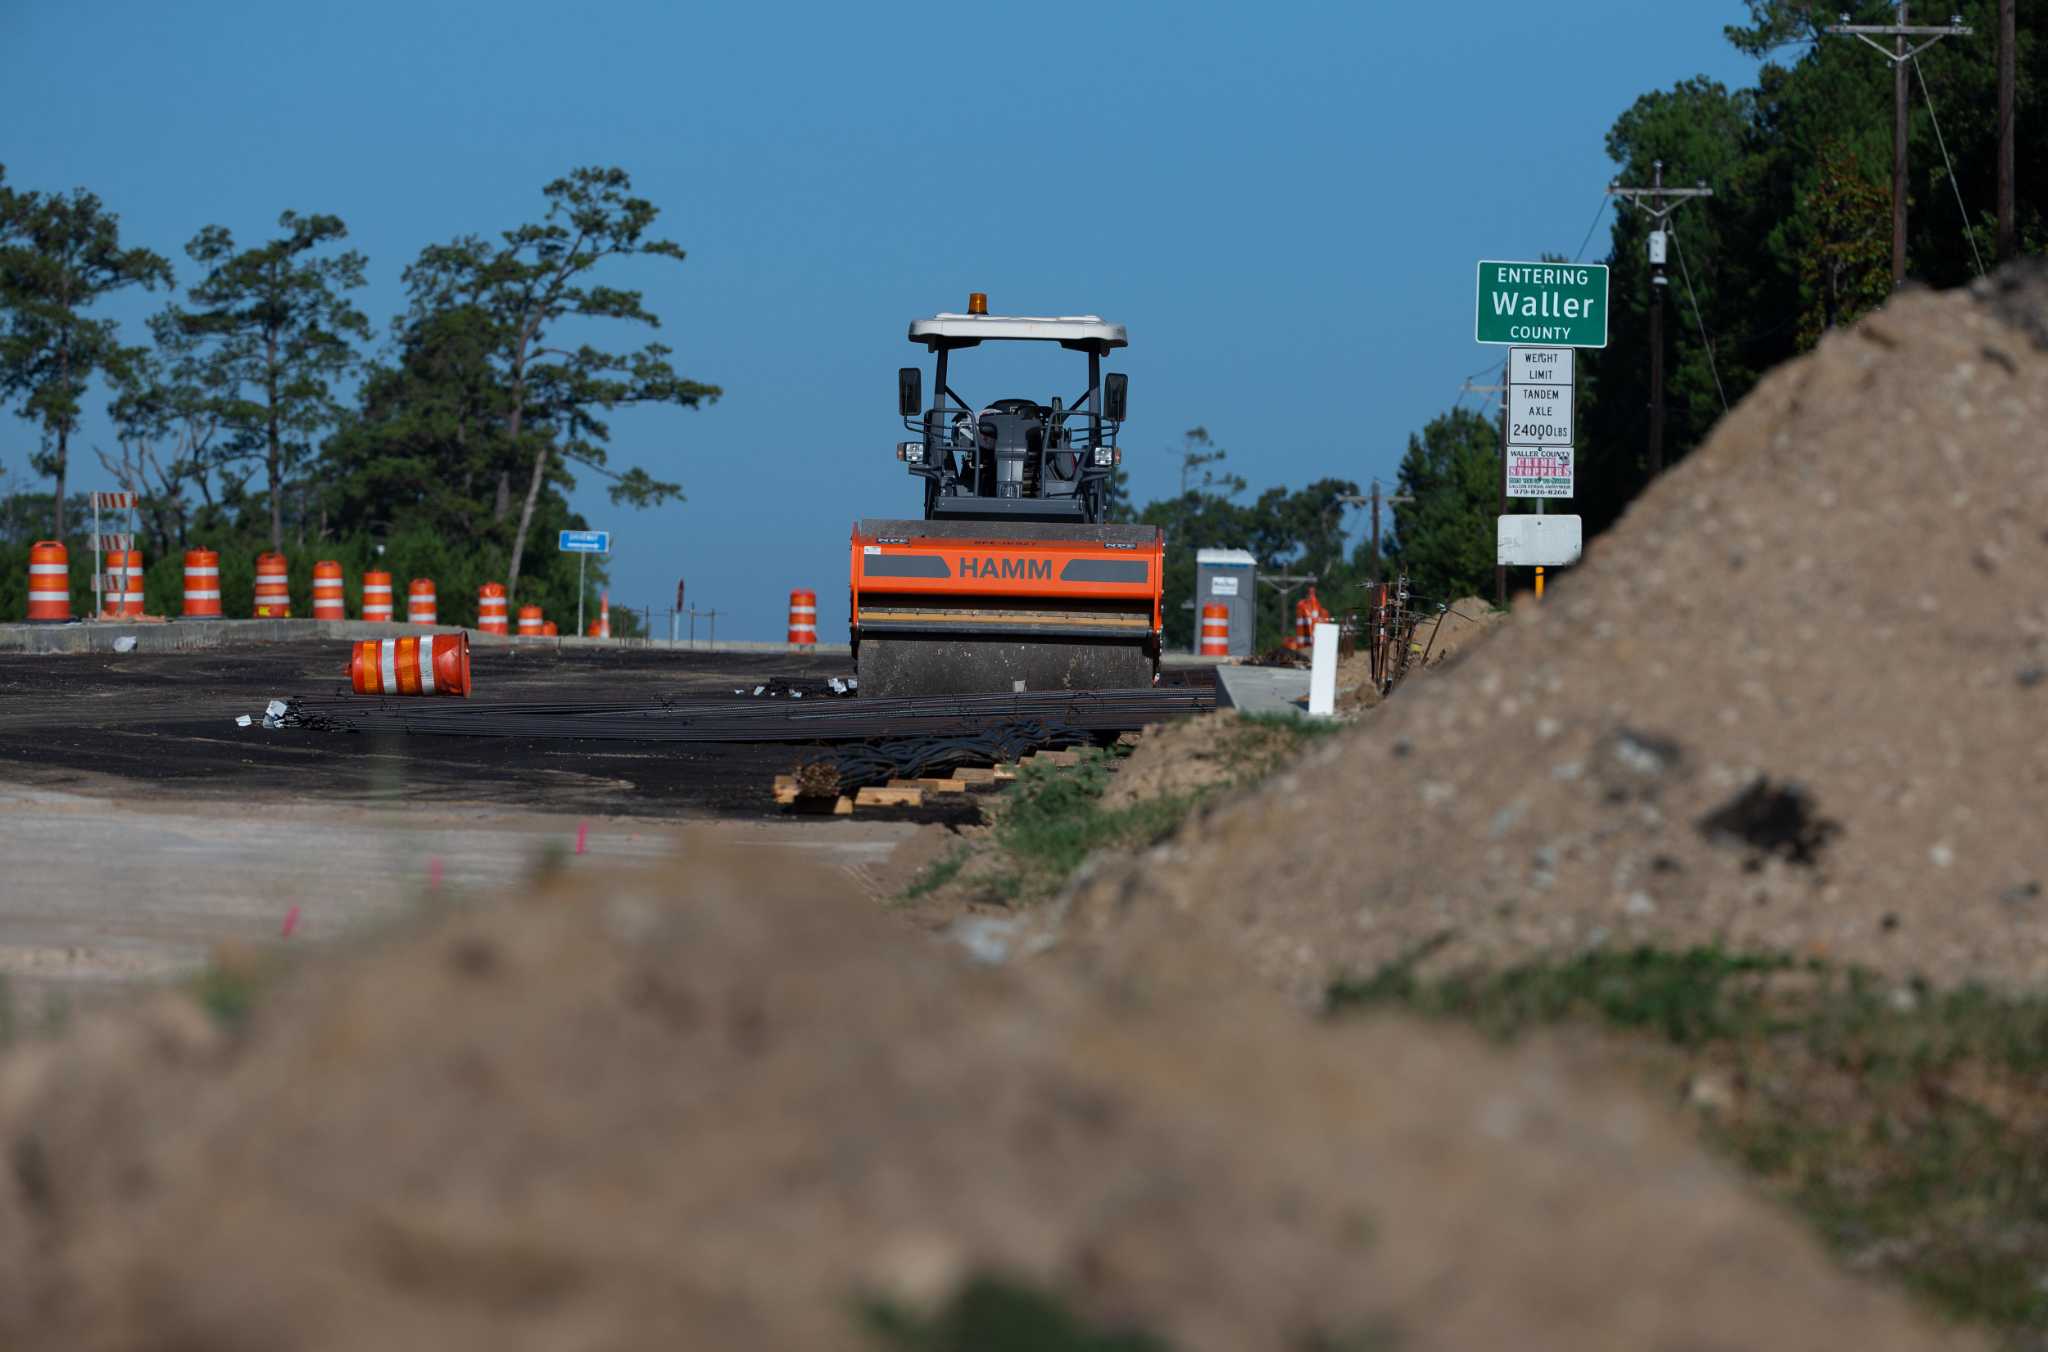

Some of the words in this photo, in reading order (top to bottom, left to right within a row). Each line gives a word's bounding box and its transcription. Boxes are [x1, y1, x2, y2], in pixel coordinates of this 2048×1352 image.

[1497, 267, 1589, 285] ENTERING
[1492, 291, 1594, 318] Waller
[1510, 326, 1571, 340] COUNTY
[1525, 353, 1558, 363] WEIGHT
[1529, 370, 1553, 380] LIMIT
[1523, 389, 1559, 400] TANDEM
[1528, 406, 1553, 416] AXLE
[959, 556, 1052, 581] HAMM
